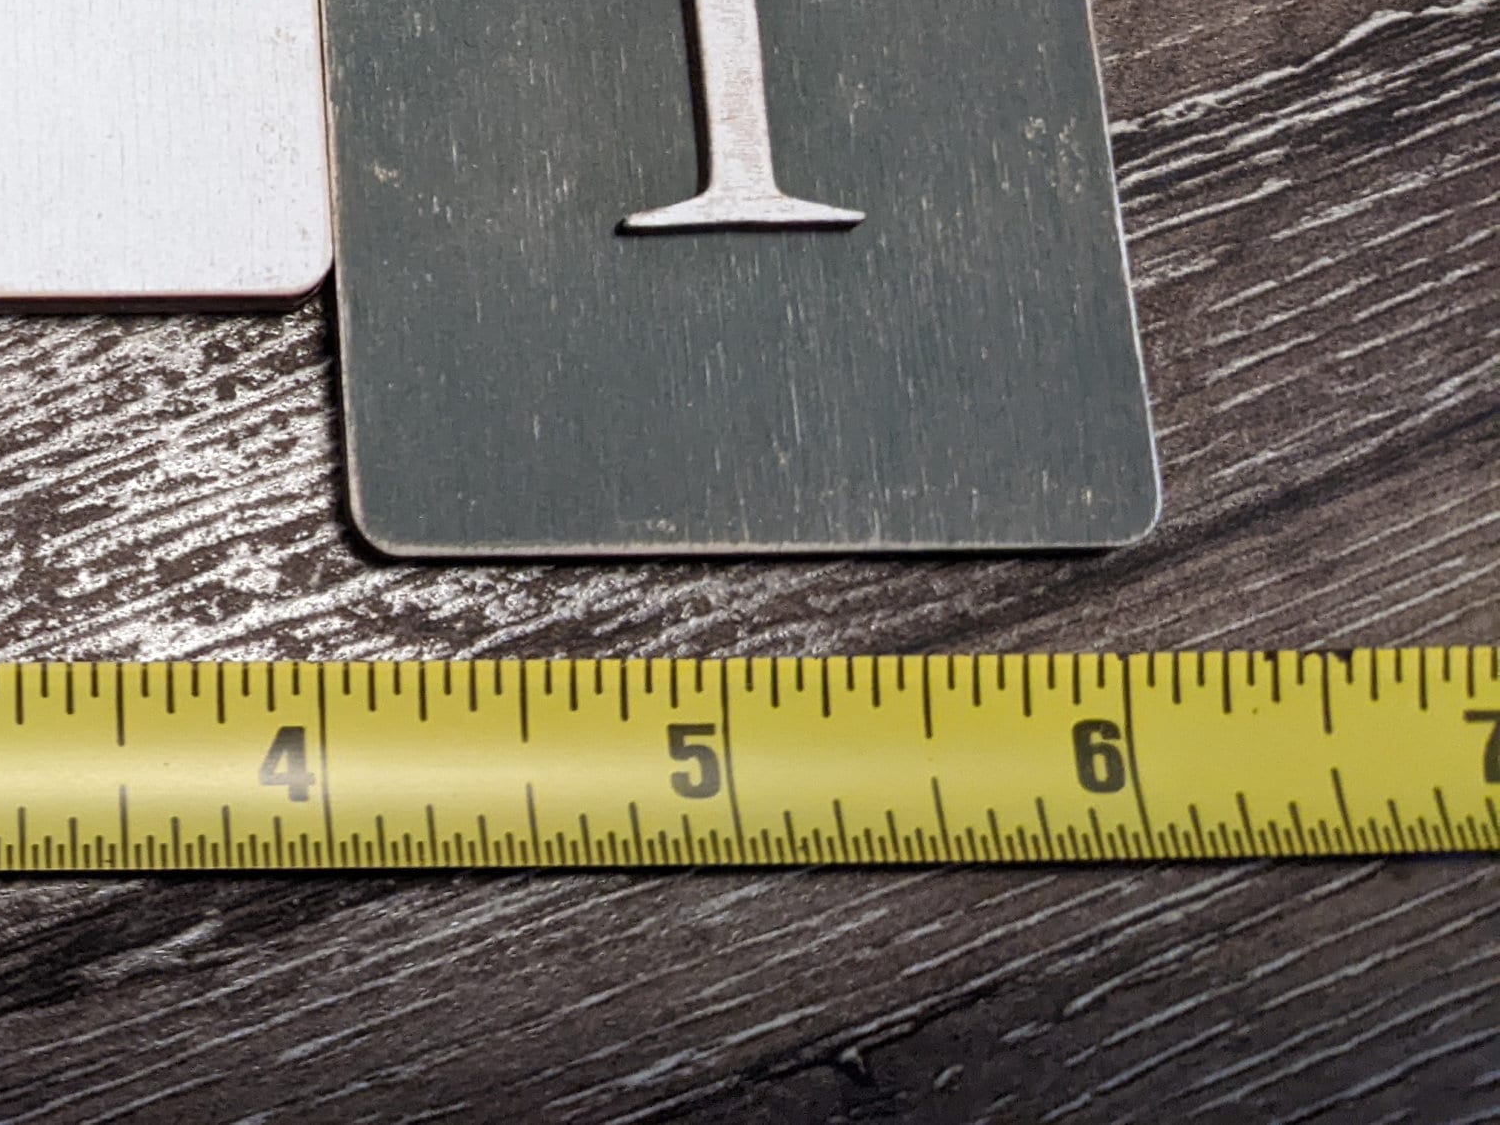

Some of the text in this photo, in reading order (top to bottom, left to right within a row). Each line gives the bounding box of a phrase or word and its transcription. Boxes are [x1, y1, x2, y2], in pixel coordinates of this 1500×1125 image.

[258, 725, 315, 802] 4
[667, 723, 721, 799] 5
[1072, 719, 1127, 794] 6
